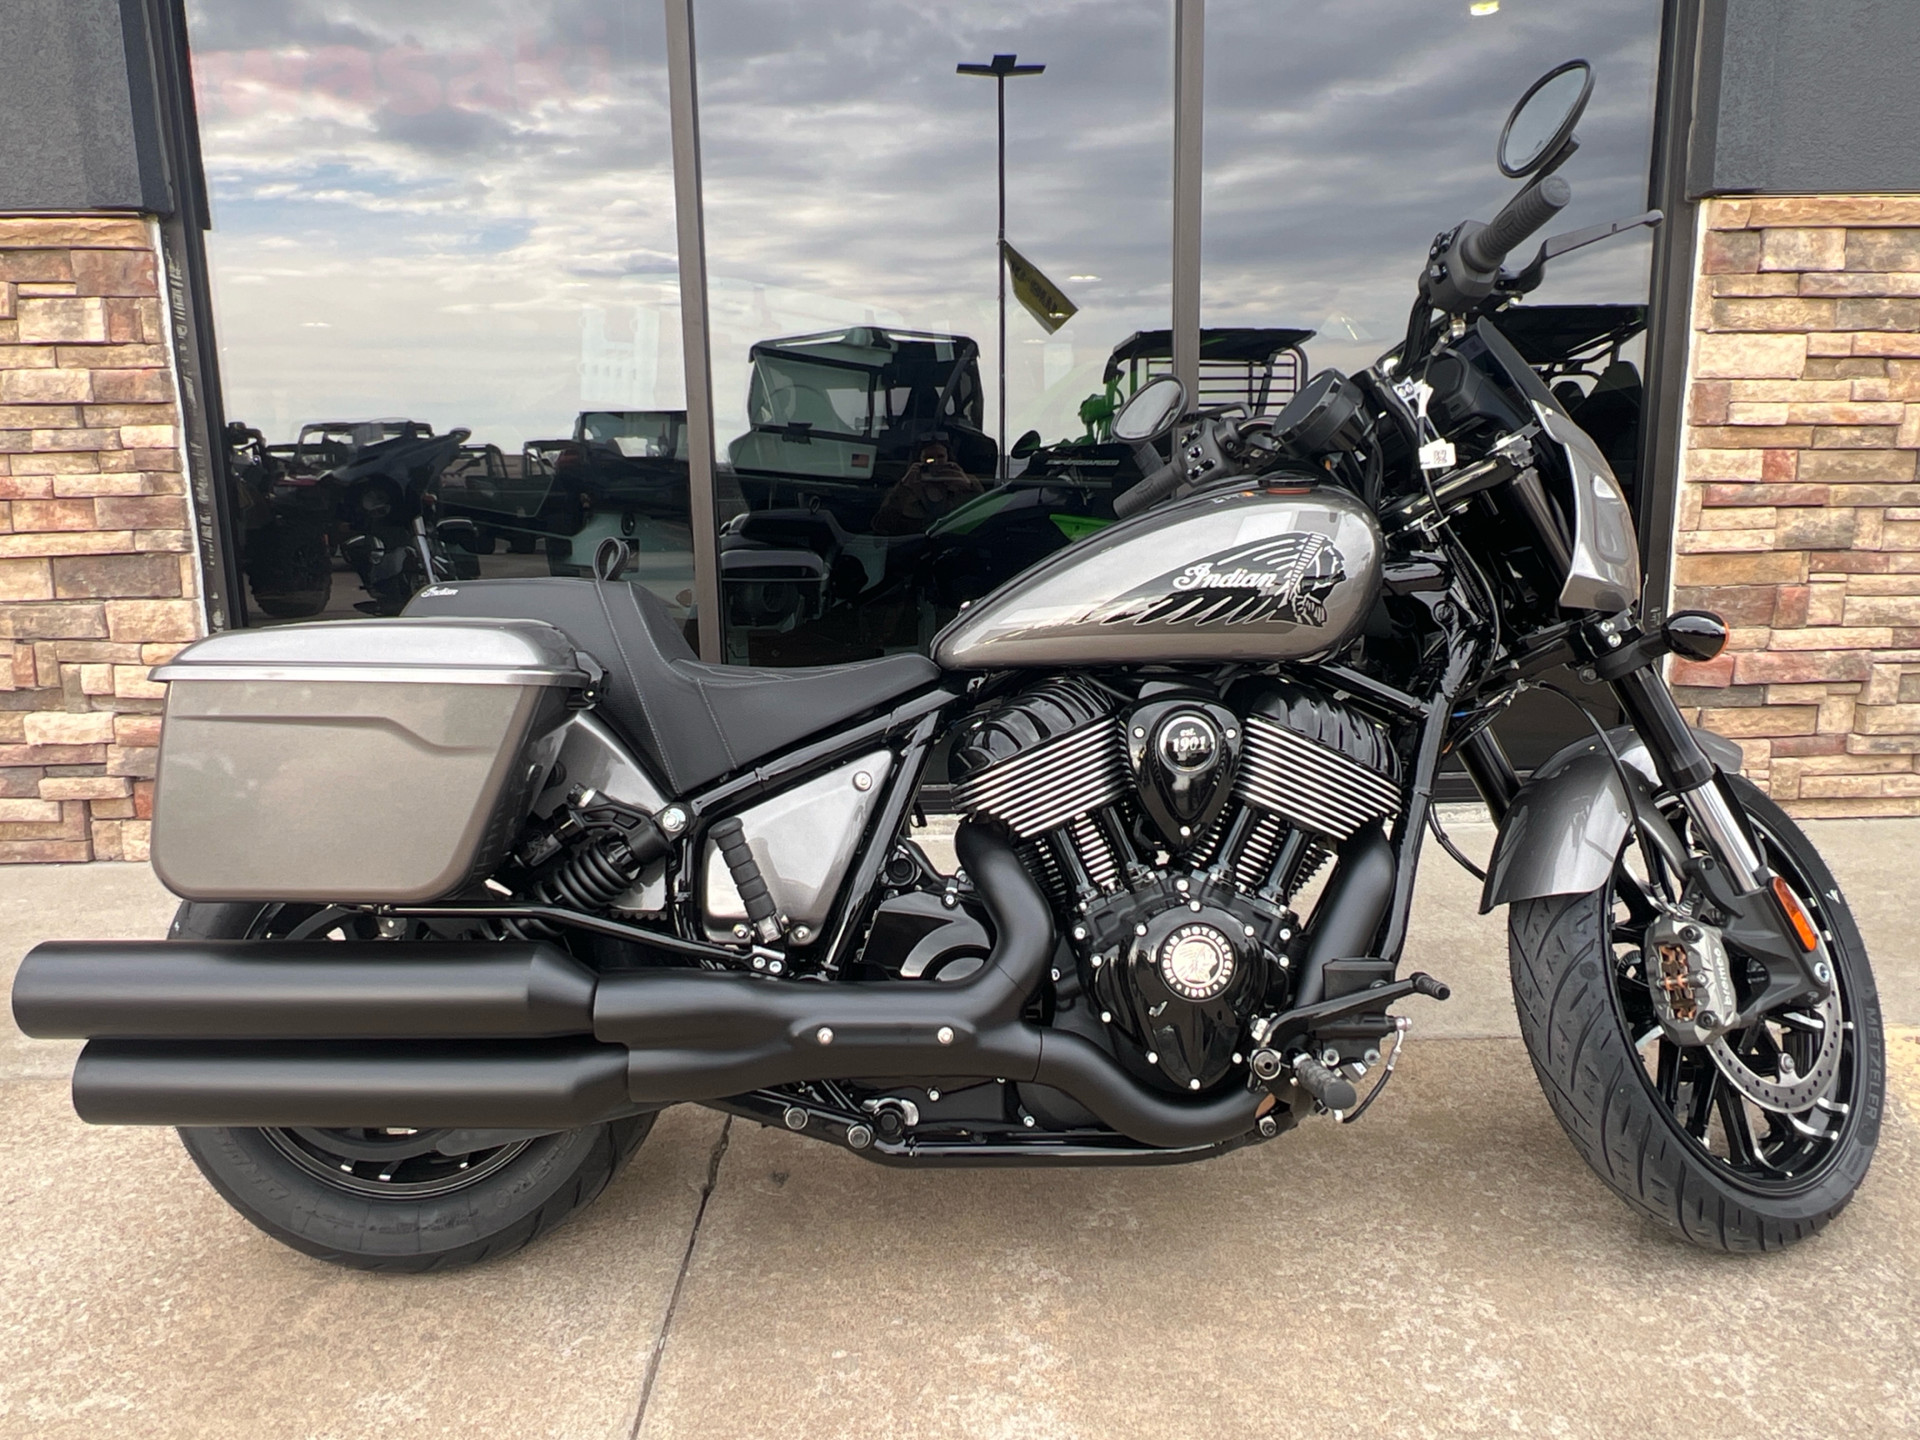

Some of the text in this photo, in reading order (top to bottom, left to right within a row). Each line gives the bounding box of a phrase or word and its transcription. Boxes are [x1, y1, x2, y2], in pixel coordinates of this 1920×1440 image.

[1172, 562, 1278, 590] Indian
[1172, 735, 1206, 753] 1901
[1162, 926, 1234, 985] INDIAN MOTORCYCLE
[1714, 947, 1733, 1006] brembo
[1864, 1006, 1882, 1120] METZELER
